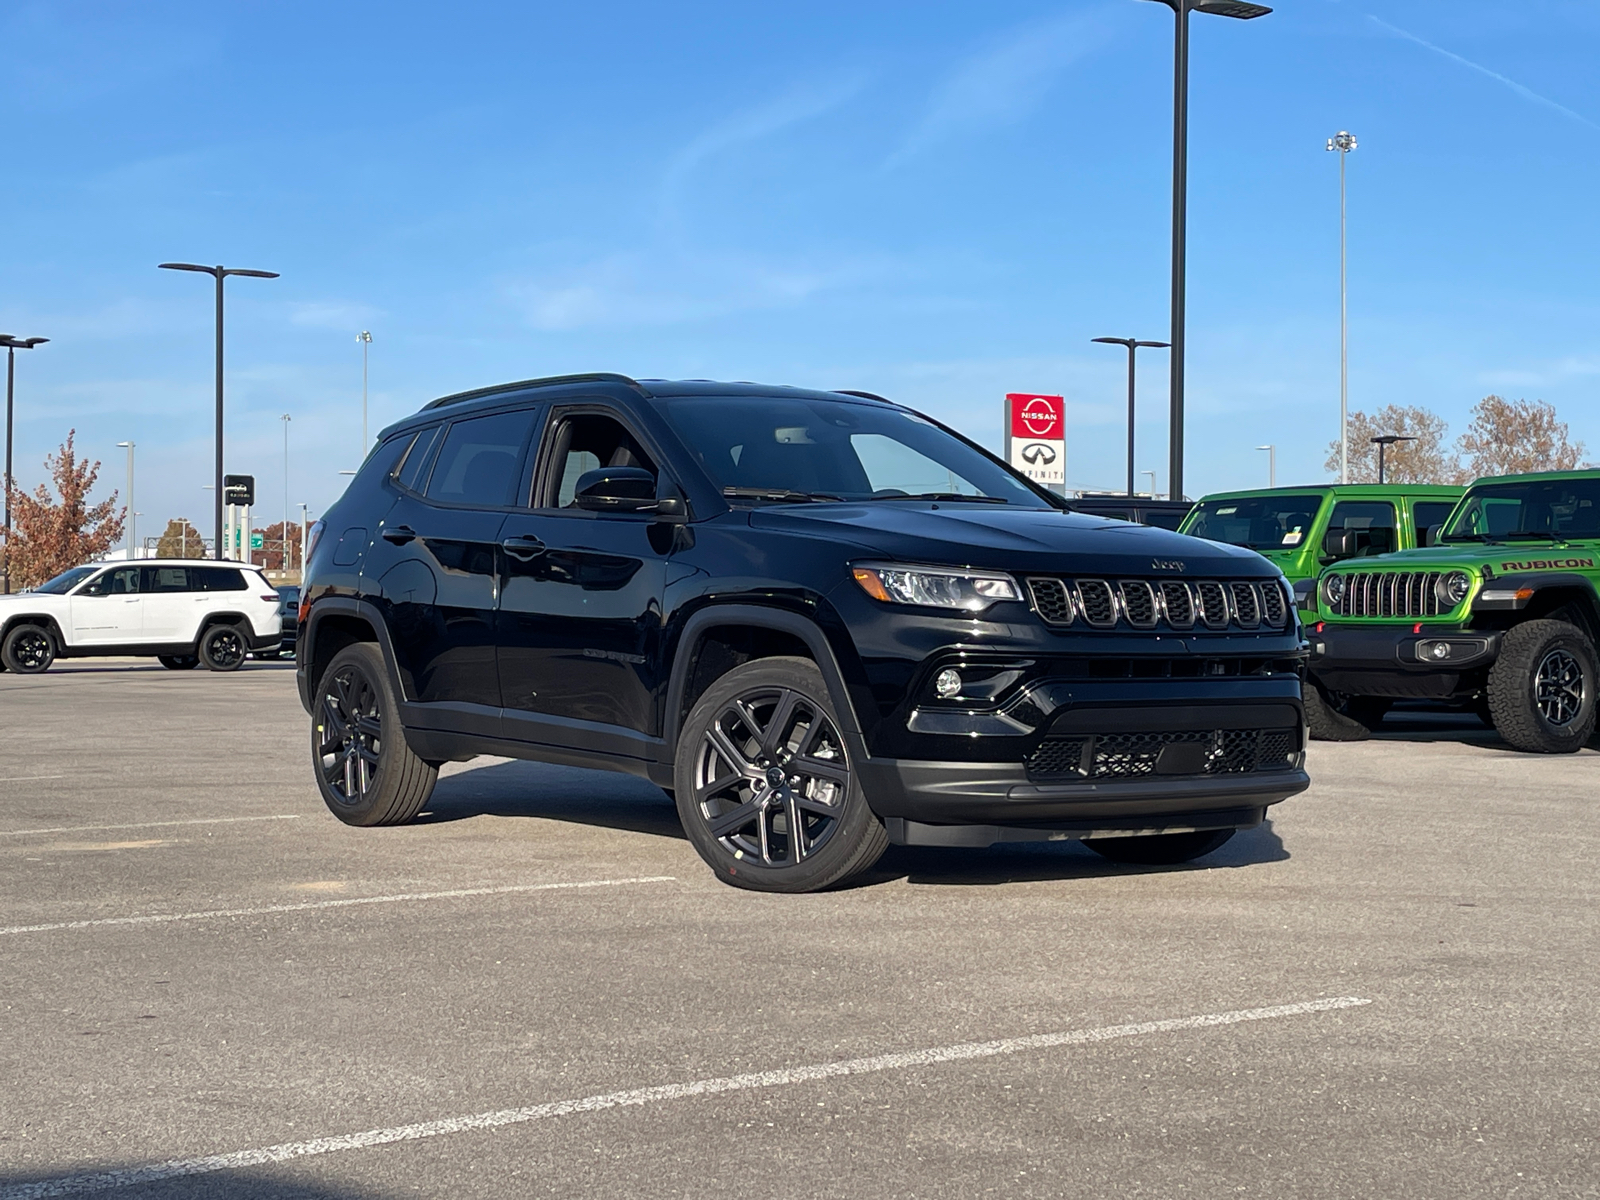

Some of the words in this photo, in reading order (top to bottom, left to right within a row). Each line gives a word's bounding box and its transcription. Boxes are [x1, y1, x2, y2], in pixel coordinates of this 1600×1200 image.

[1021, 412, 1057, 420] NISSAN
[1020, 470, 1063, 479] FINITI
[1151, 558, 1186, 572] Jeep
[1501, 559, 1593, 571] RUBICON
